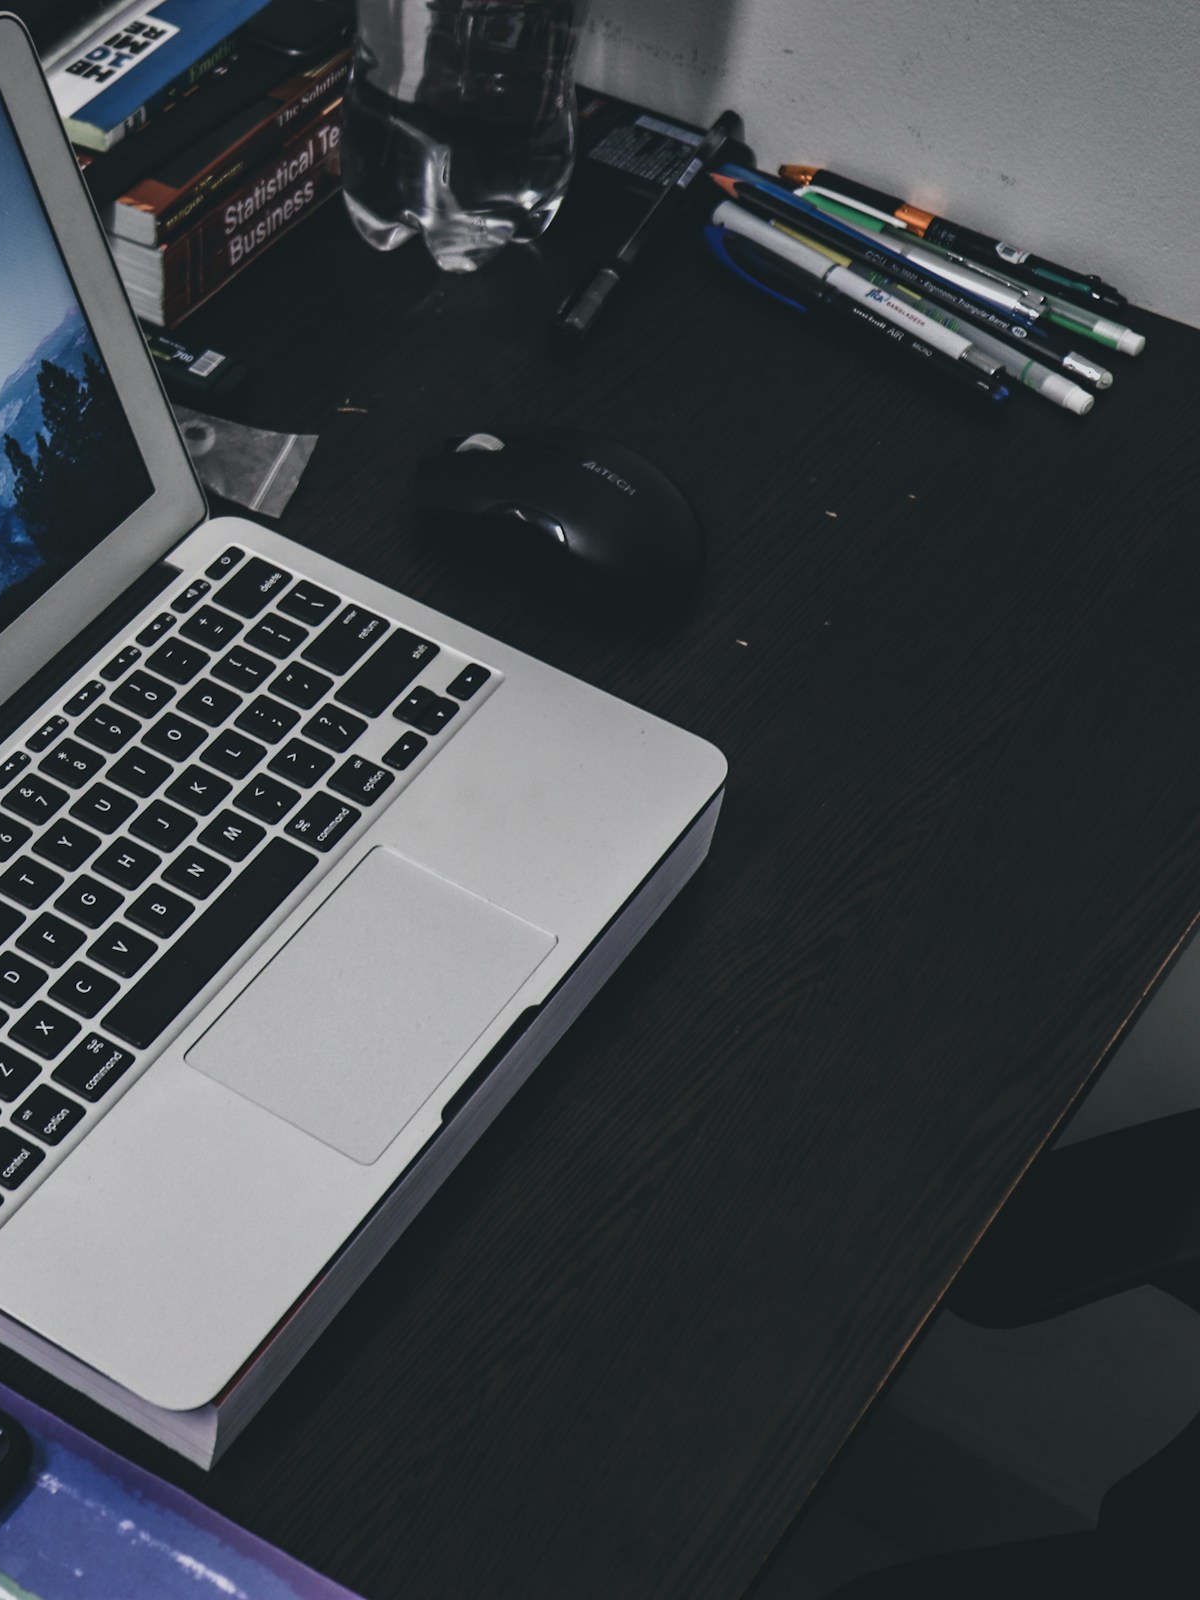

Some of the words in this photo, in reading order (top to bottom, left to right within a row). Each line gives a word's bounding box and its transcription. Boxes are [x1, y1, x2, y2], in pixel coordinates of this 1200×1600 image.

[224, 140, 314, 236] Statistical
[228, 180, 315, 267] Business
[923, 281, 957, 303] Ergonomic
[957, 298, 990, 319] Triangular
[988, 314, 1010, 329] Barrel
[886, 301, 926, 327] BANGLADESH
[886, 328, 905, 341] AIR
[172, 350, 194, 363] 700
[260, 573, 282, 592] delete
[359, 620, 379, 639] return
[412, 645, 427, 659] shift
[144, 691, 158, 701] 0
[202, 696, 214, 706] P
[109, 725, 122, 735] 9
[167, 730, 181, 740] O
[225, 748, 242, 758] L
[74, 761, 86, 770] 8
[363, 771, 385, 791] option
[190, 782, 207, 794] K
[36, 795, 49, 807] 7
[95, 799, 111, 811] U
[157, 818, 169, 829] J
[317, 808, 349, 841] command
[0, 833, 12, 842] 6
[223, 826, 242, 841] M
[58, 836, 72, 846] Y
[118, 854, 135, 868] H
[187, 864, 205, 877] N
[20, 874, 34, 884] T
[81, 893, 96, 905] G
[151, 904, 166, 915] B
[43, 931, 55, 943] F
[112, 941, 128, 952] V
[4, 971, 20, 983] D
[76, 981, 91, 993] C
[35, 1021, 54, 1035] X
[85, 1051, 122, 1091] command
[44, 1109, 70, 1134] option
[3, 1149, 30, 1177] control
